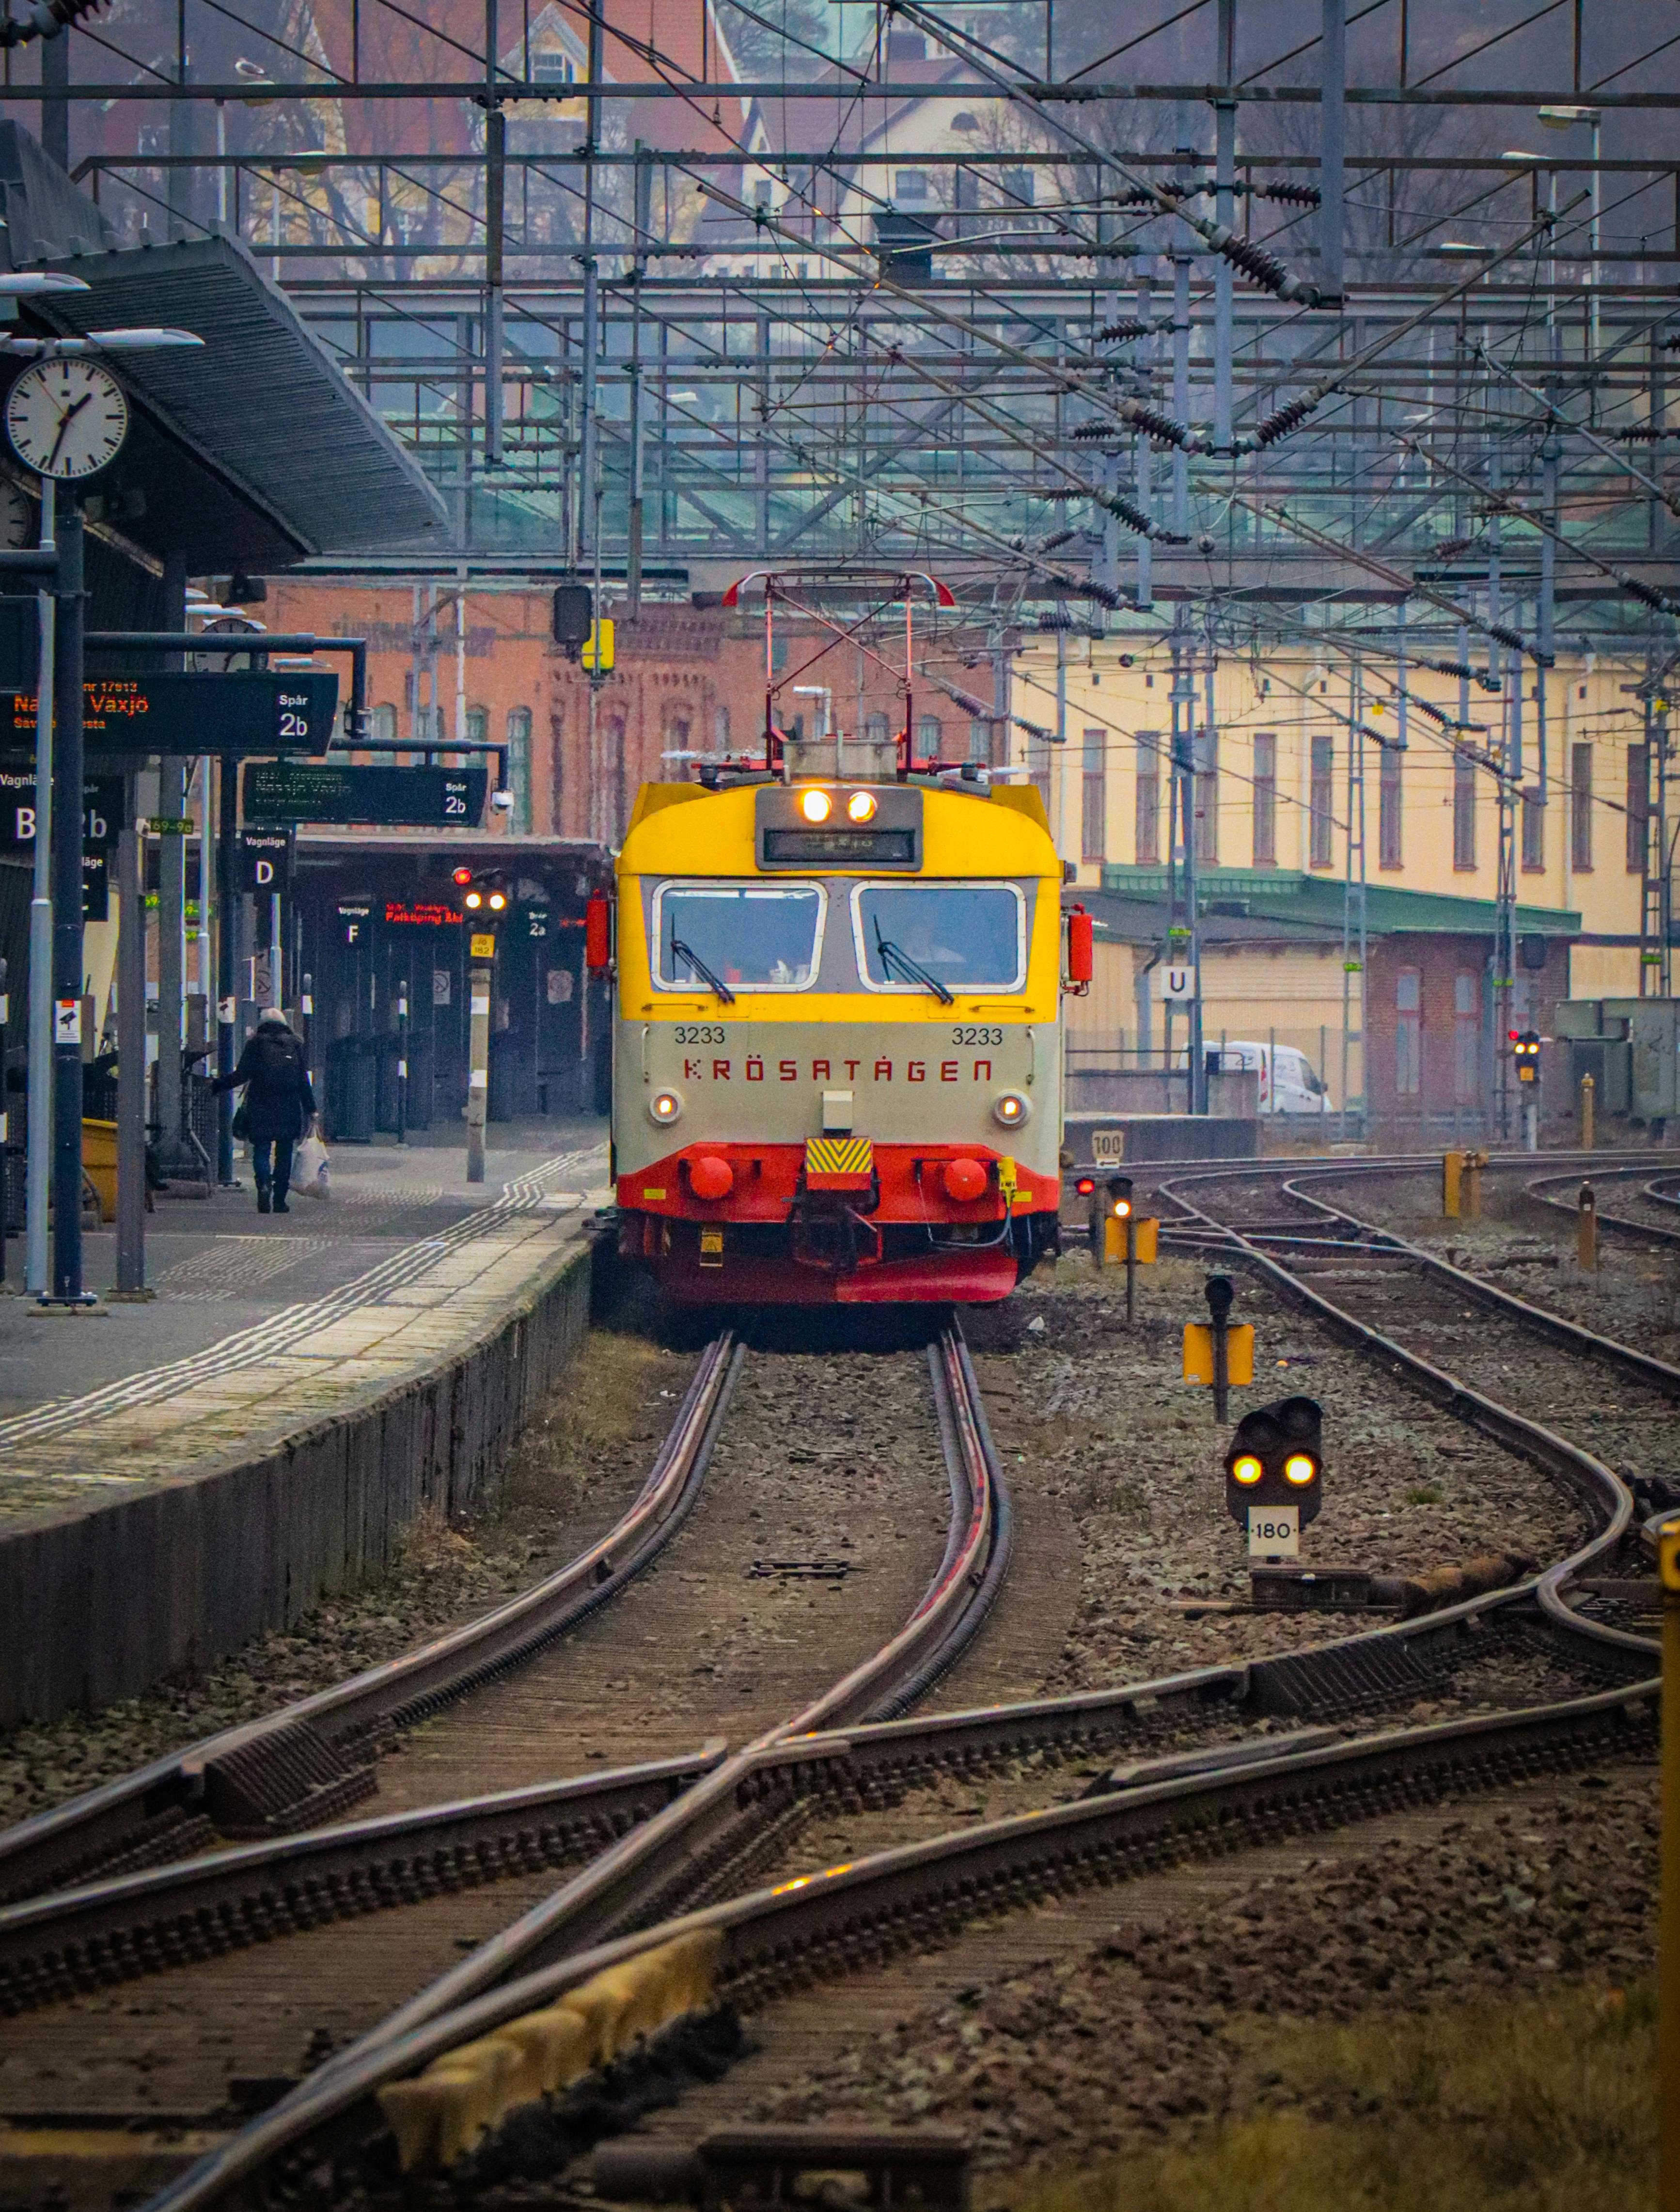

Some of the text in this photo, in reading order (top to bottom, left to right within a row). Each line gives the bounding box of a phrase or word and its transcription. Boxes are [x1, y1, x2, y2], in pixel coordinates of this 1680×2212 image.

[90, 694, 149, 718] Växjö
[279, 695, 308, 707] Spår
[279, 713, 308, 736] 2b
[446, 783, 467, 793] Spår
[446, 797, 466, 814] 2b
[16, 807, 36, 839] B
[246, 837, 285, 848] Vagnläge
[256, 861, 273, 884] D
[347, 925, 358, 943] F
[1170, 972, 1185, 992] U
[675, 1027, 725, 1044] 3233
[952, 1028, 1003, 1045] 3233
[684, 1054, 992, 1082] KRÖSATÅGEN
[1094, 1136, 1120, 1154] 100
[1256, 1523, 1290, 1539] 180
